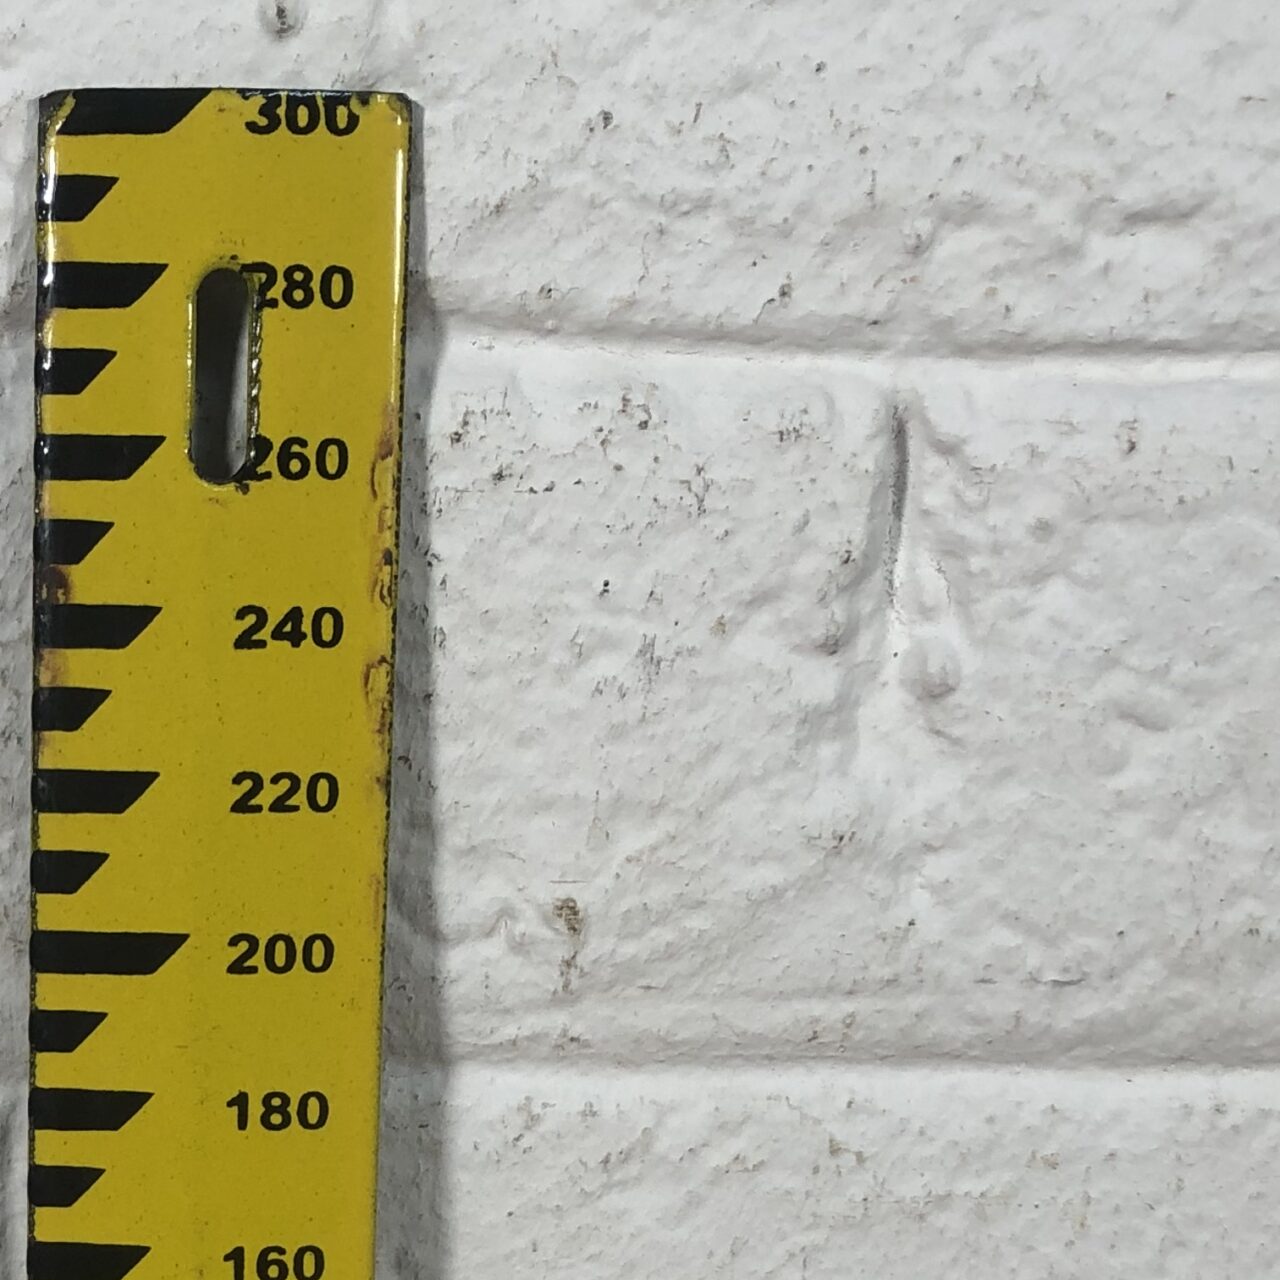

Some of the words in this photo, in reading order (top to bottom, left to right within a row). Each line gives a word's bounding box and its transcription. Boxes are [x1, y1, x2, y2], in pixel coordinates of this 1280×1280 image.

[245, 93, 360, 136] 300
[240, 262, 354, 309] 280
[234, 605, 343, 650] 240
[230, 771, 339, 814] 220
[227, 933, 334, 975] 200
[227, 1091, 328, 1131] 180
